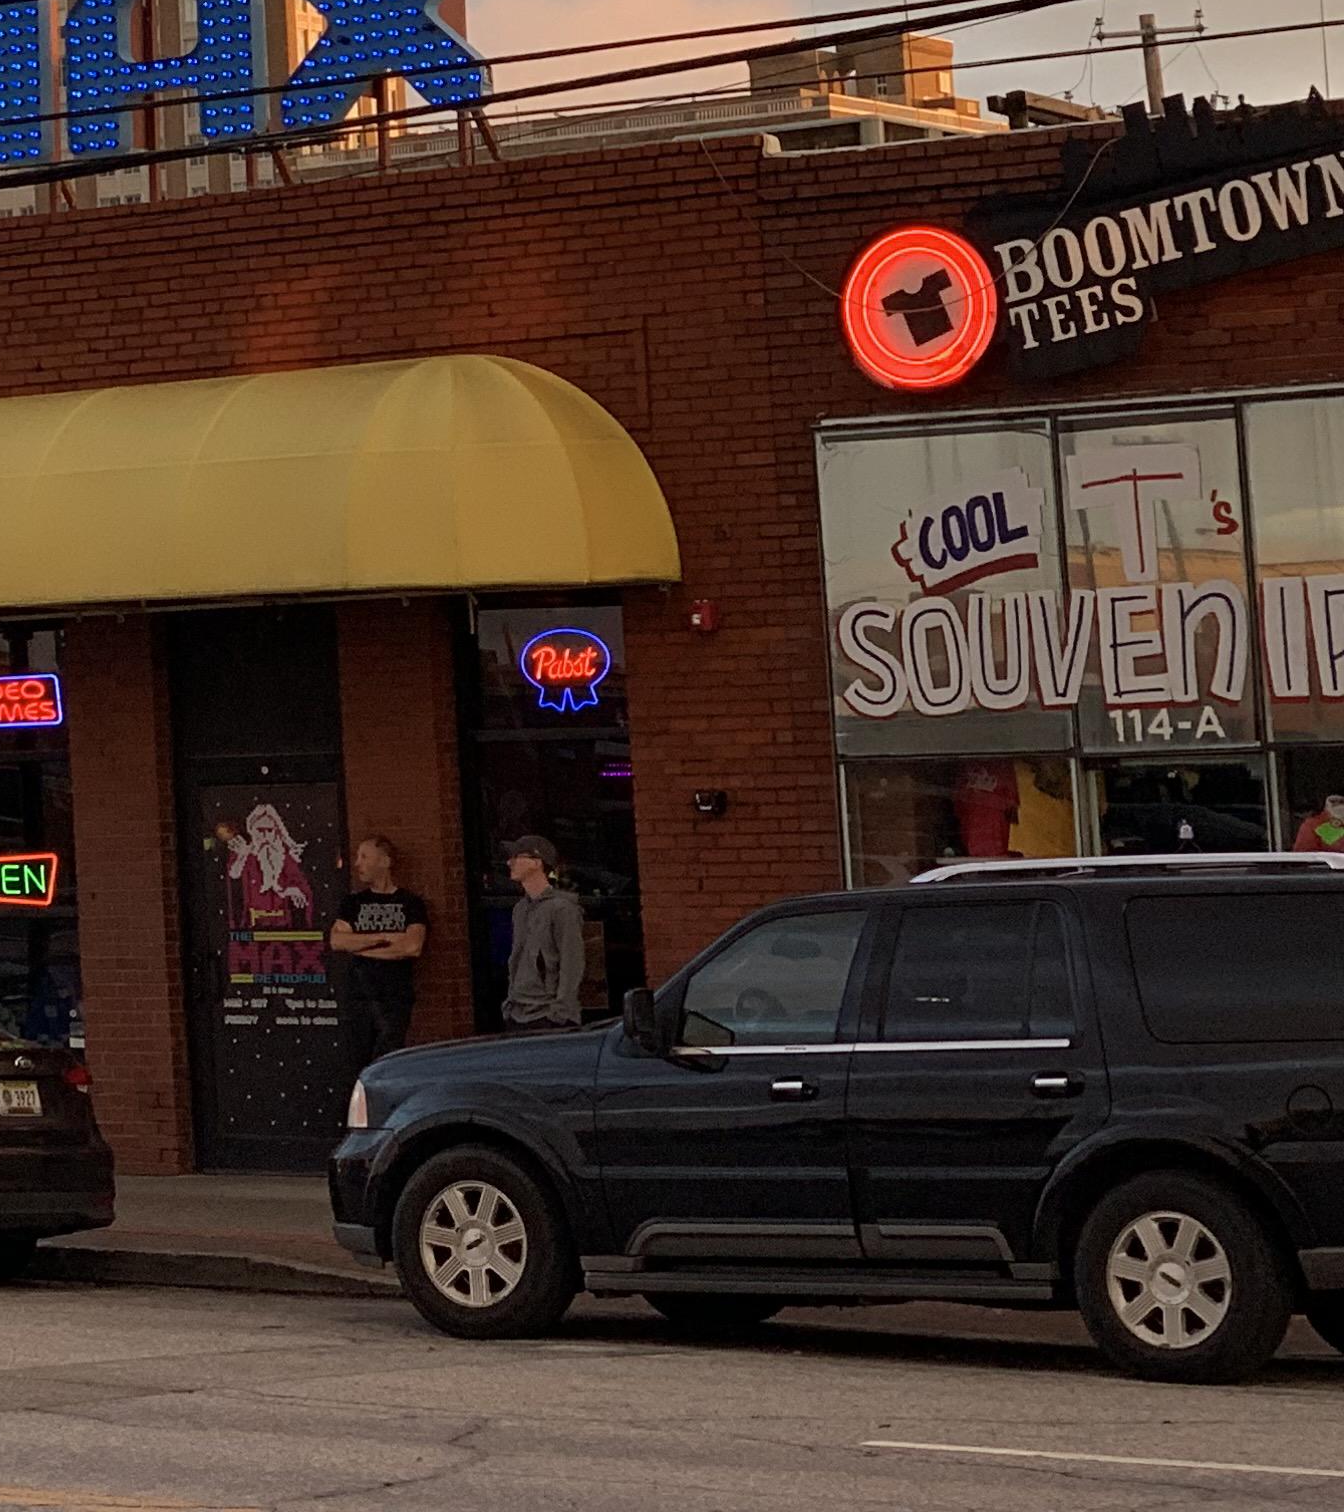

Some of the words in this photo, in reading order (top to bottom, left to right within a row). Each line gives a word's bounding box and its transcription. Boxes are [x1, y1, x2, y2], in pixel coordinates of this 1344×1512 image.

[1009, 277, 1146, 350] TEES
[918, 491, 1029, 570] COOL
[532, 646, 598, 680] Pabst
[1109, 705, 1226, 744] 114-A
